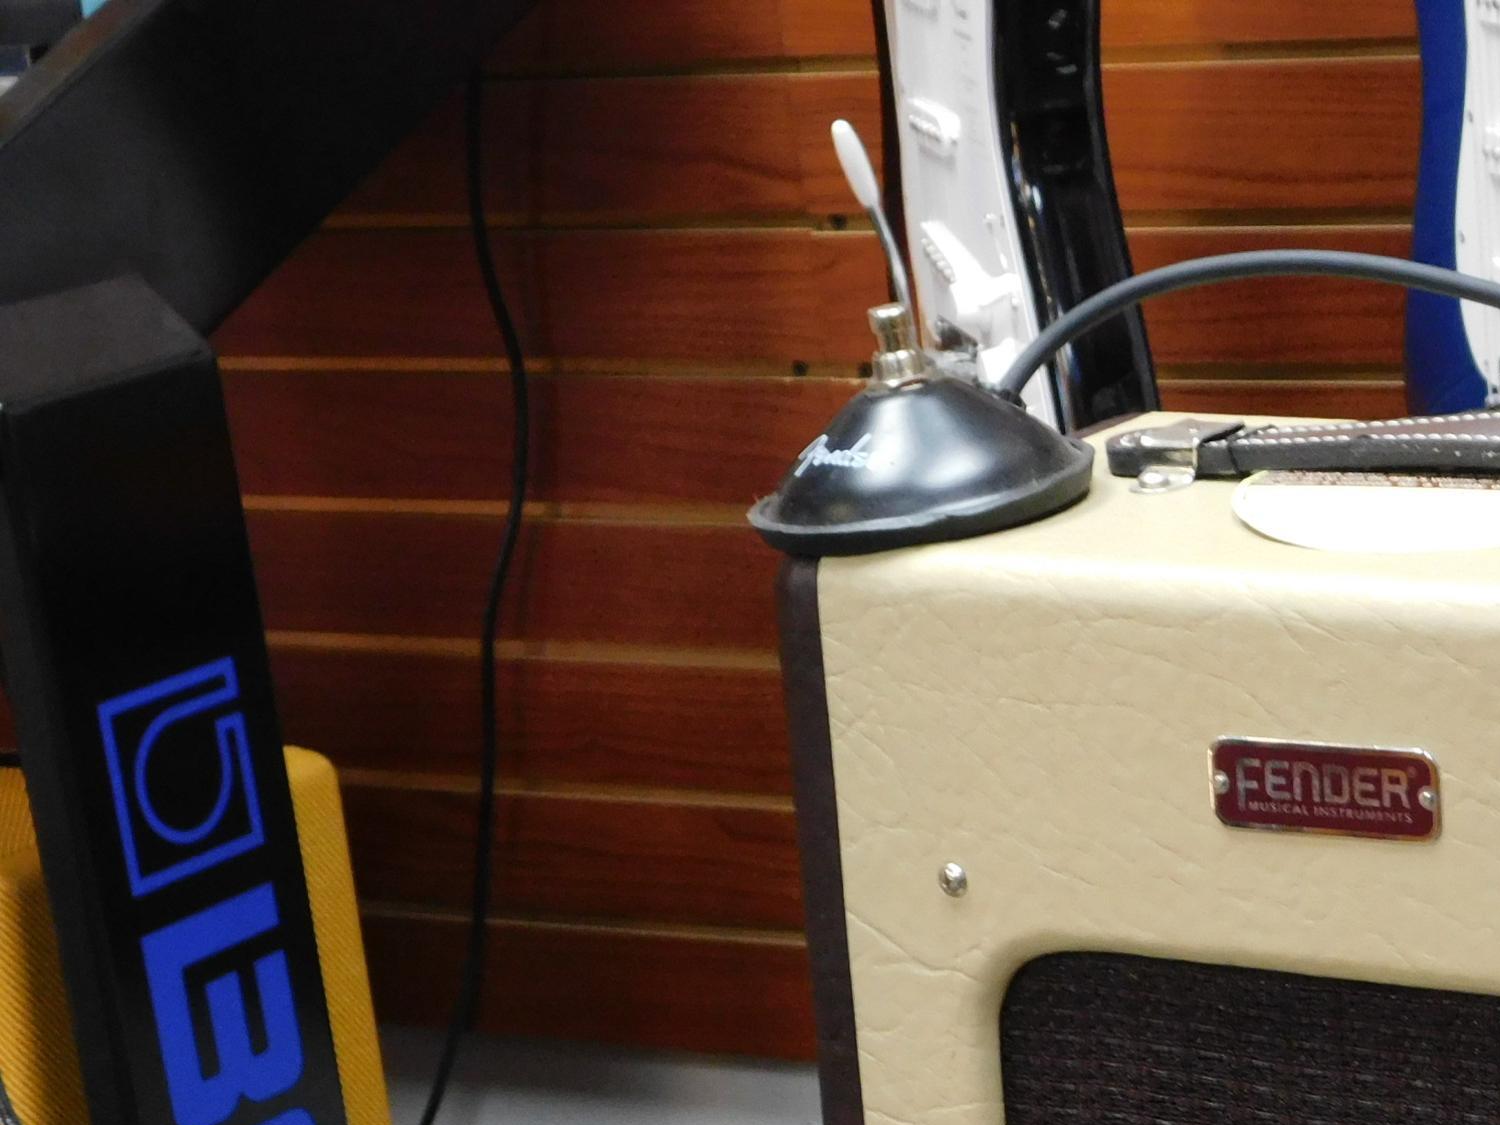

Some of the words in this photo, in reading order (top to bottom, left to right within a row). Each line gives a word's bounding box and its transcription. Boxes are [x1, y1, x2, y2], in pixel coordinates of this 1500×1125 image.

[1235, 757, 1412, 812] FENDER
[1248, 800, 1309, 817] MUSICAL
[1313, 806, 1414, 825] INSTRUMENTS
